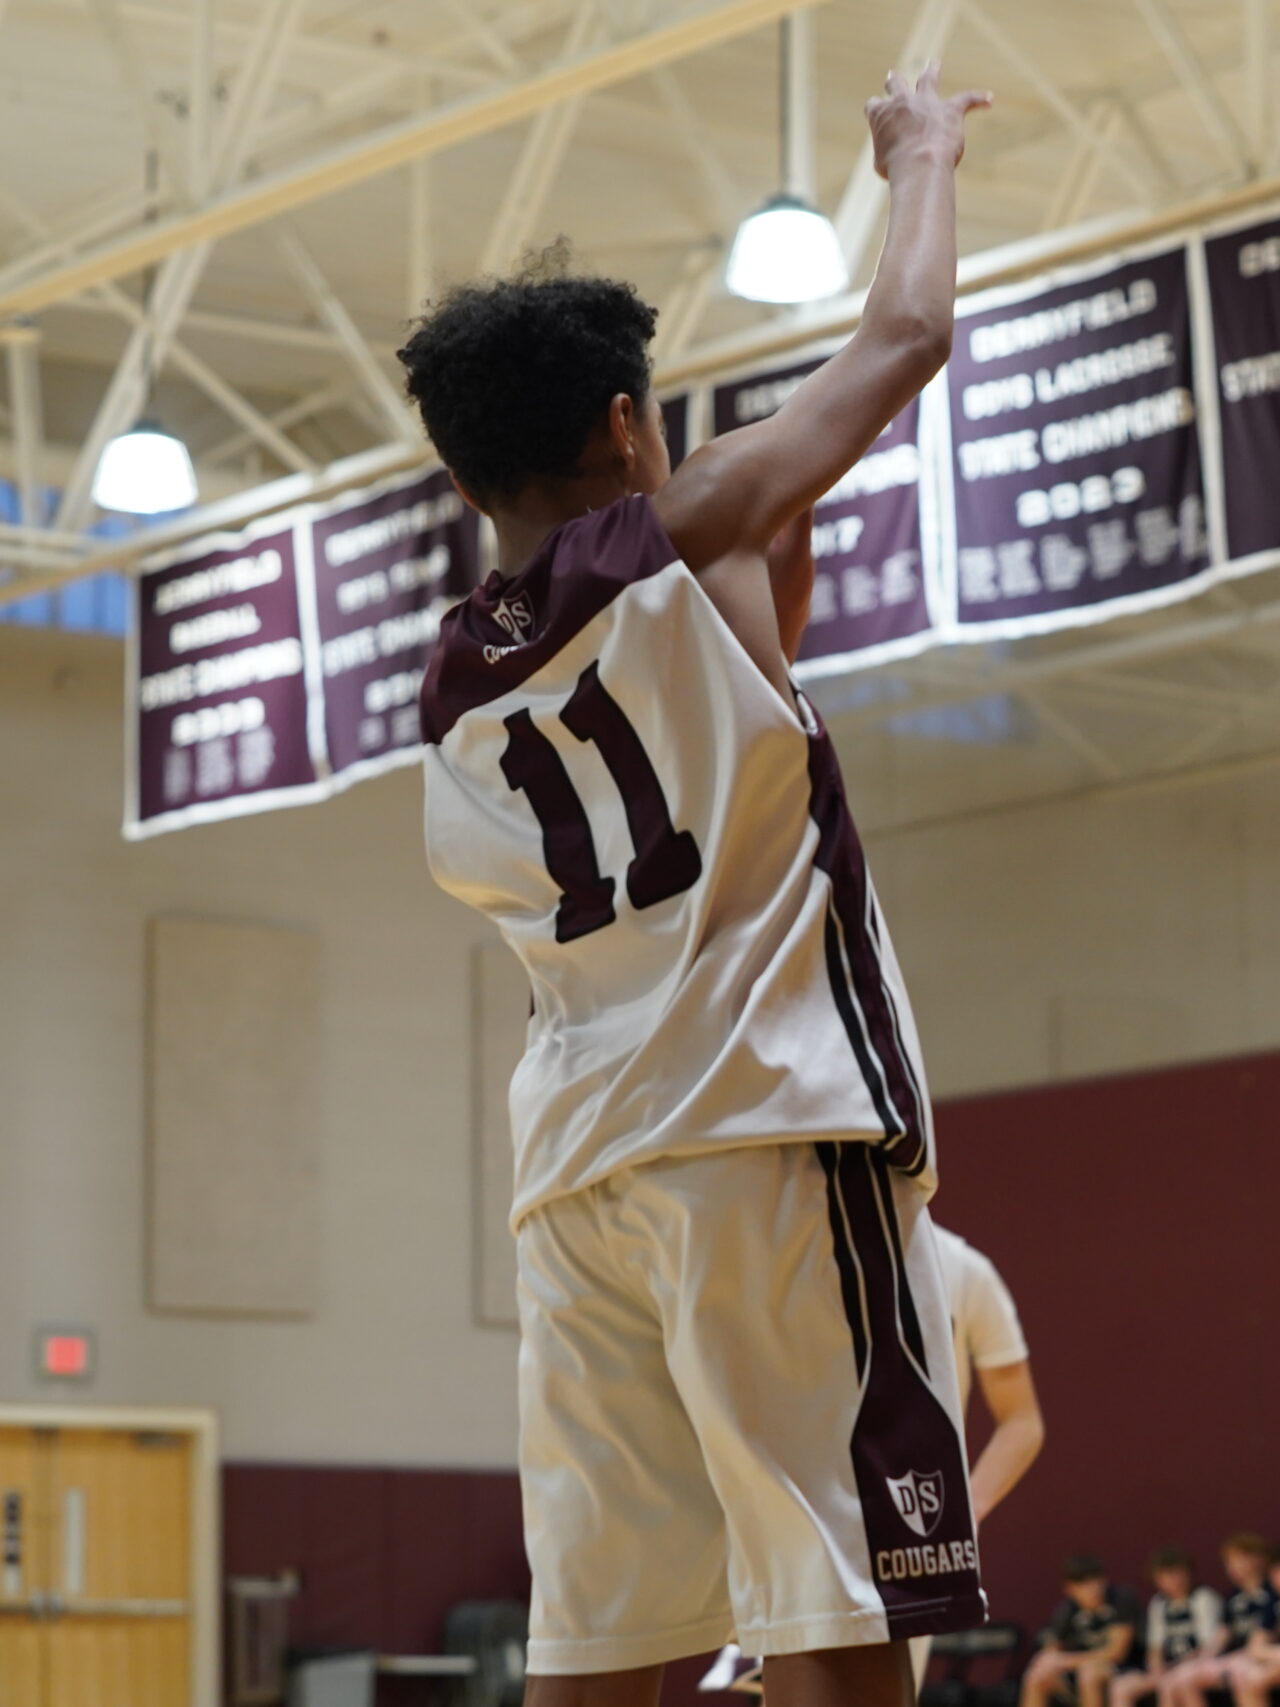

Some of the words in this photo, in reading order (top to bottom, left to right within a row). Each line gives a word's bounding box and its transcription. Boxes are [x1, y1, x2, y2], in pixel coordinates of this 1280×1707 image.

[500, 658, 702, 944] 11
[898, 1480, 941, 1515] DS
[876, 1539, 977, 1582] COUGARS
